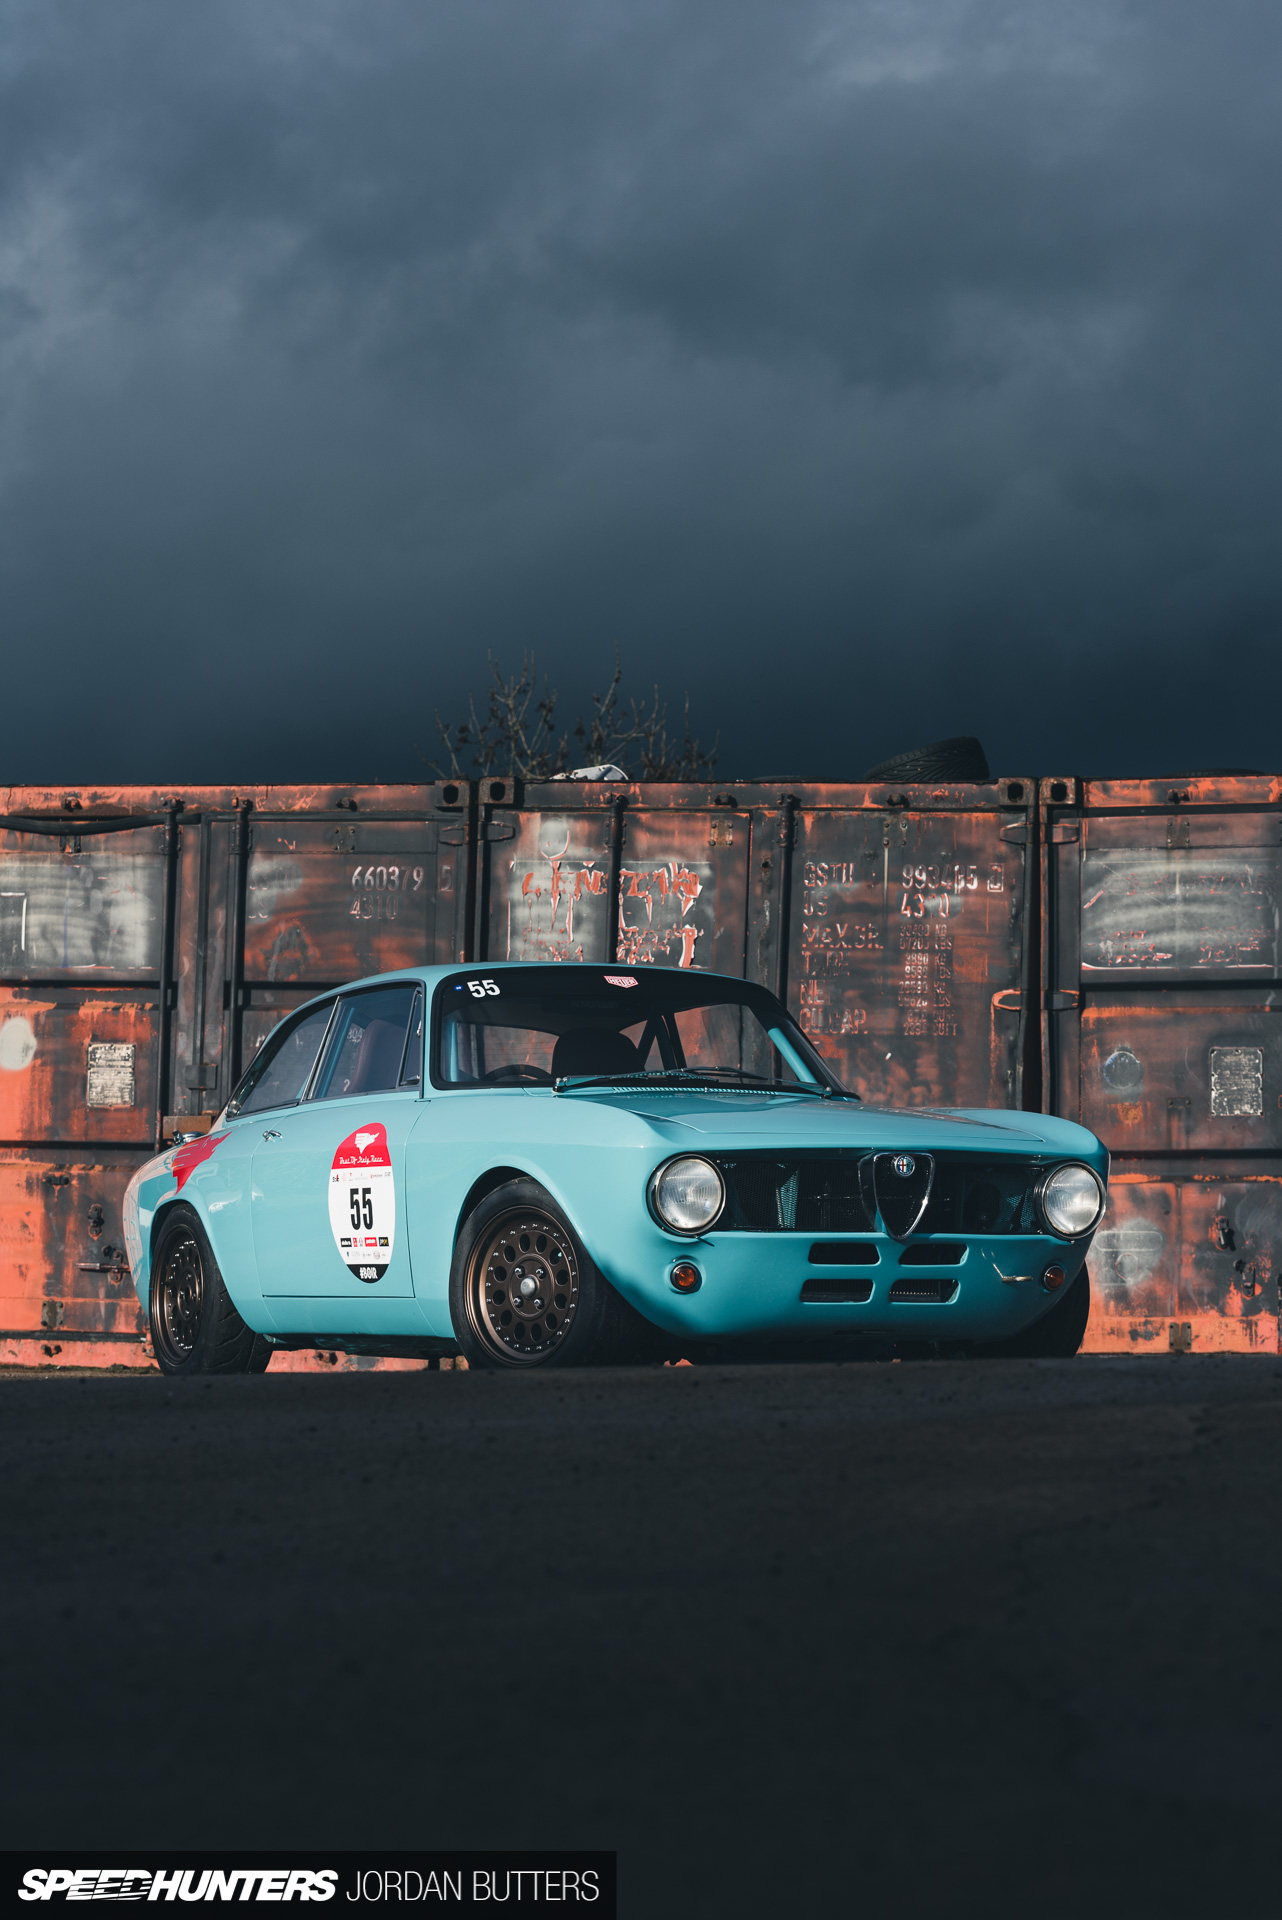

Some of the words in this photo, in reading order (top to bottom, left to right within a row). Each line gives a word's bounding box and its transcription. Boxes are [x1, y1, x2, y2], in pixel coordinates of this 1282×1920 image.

[352, 866, 424, 891] 660379
[804, 862, 855, 888] GSTU
[901, 893, 950, 917] 430
[467, 979, 500, 998] 55
[350, 1187, 373, 1230] 55
